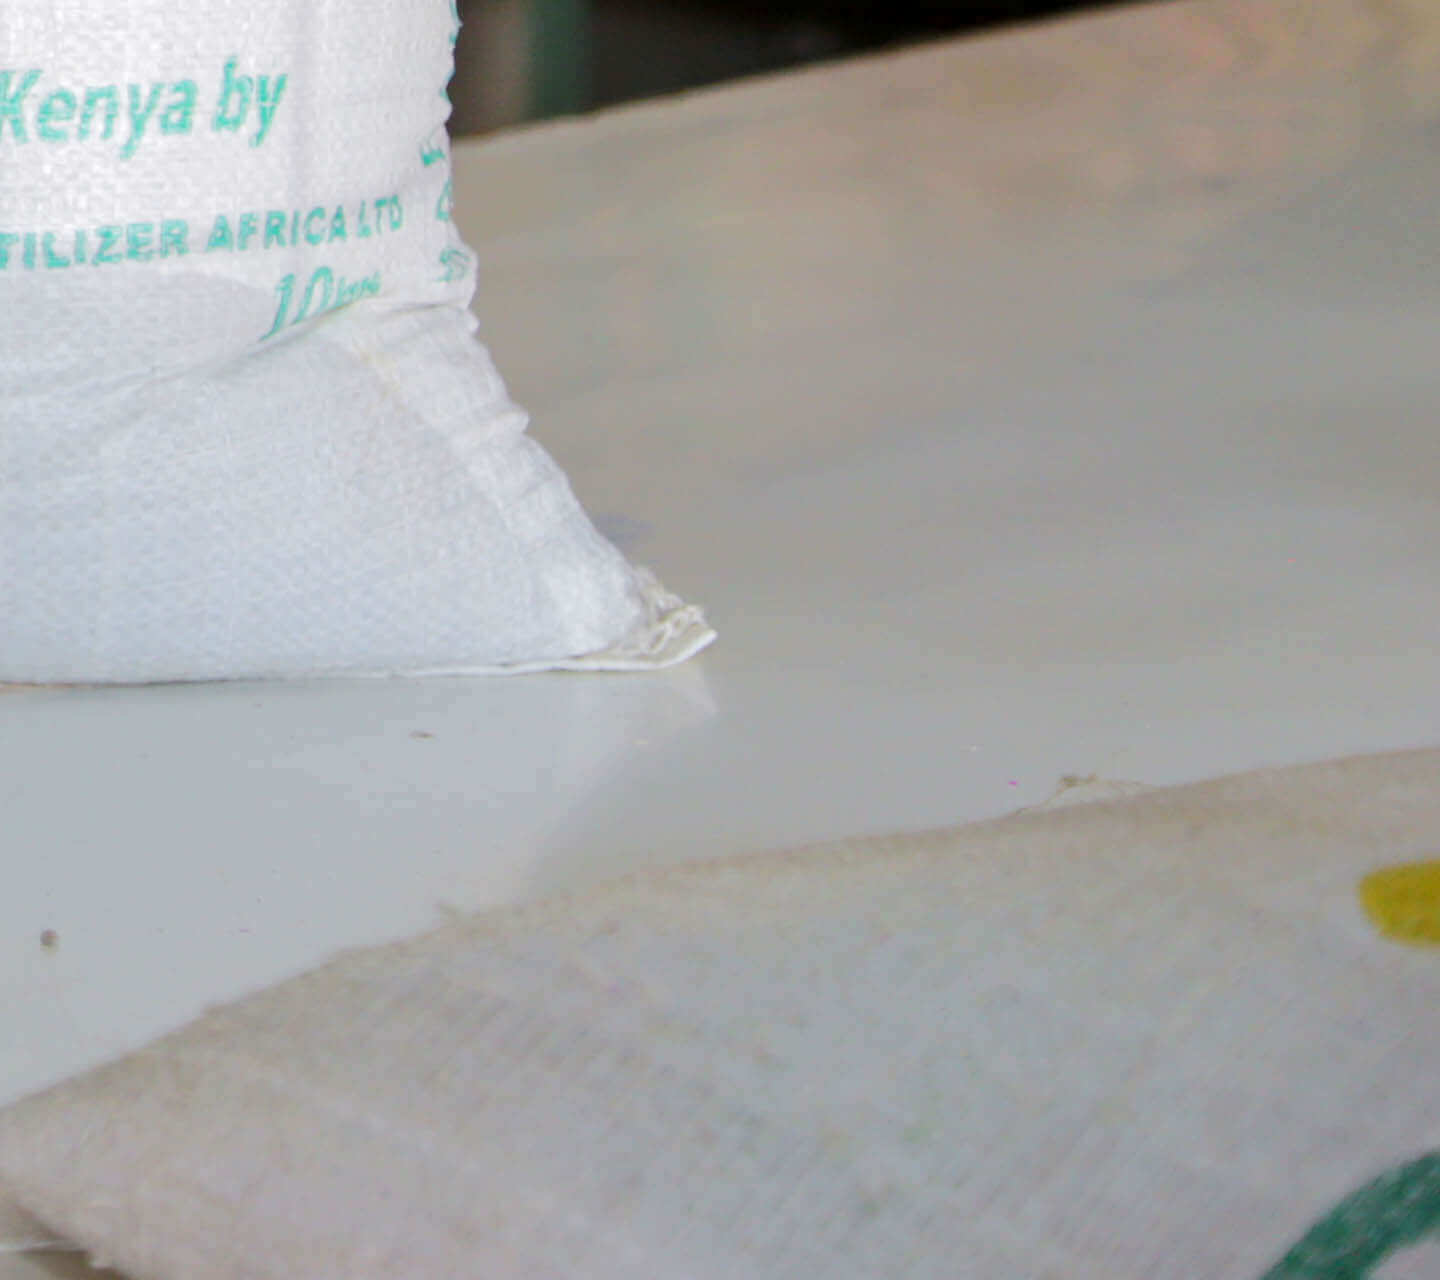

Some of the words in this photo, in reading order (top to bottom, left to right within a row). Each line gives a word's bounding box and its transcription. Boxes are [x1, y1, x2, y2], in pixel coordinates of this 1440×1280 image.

[212, 56, 288, 148] by
[205, 204, 349, 252] AFRICA
[357, 194, 403, 239] LTD
